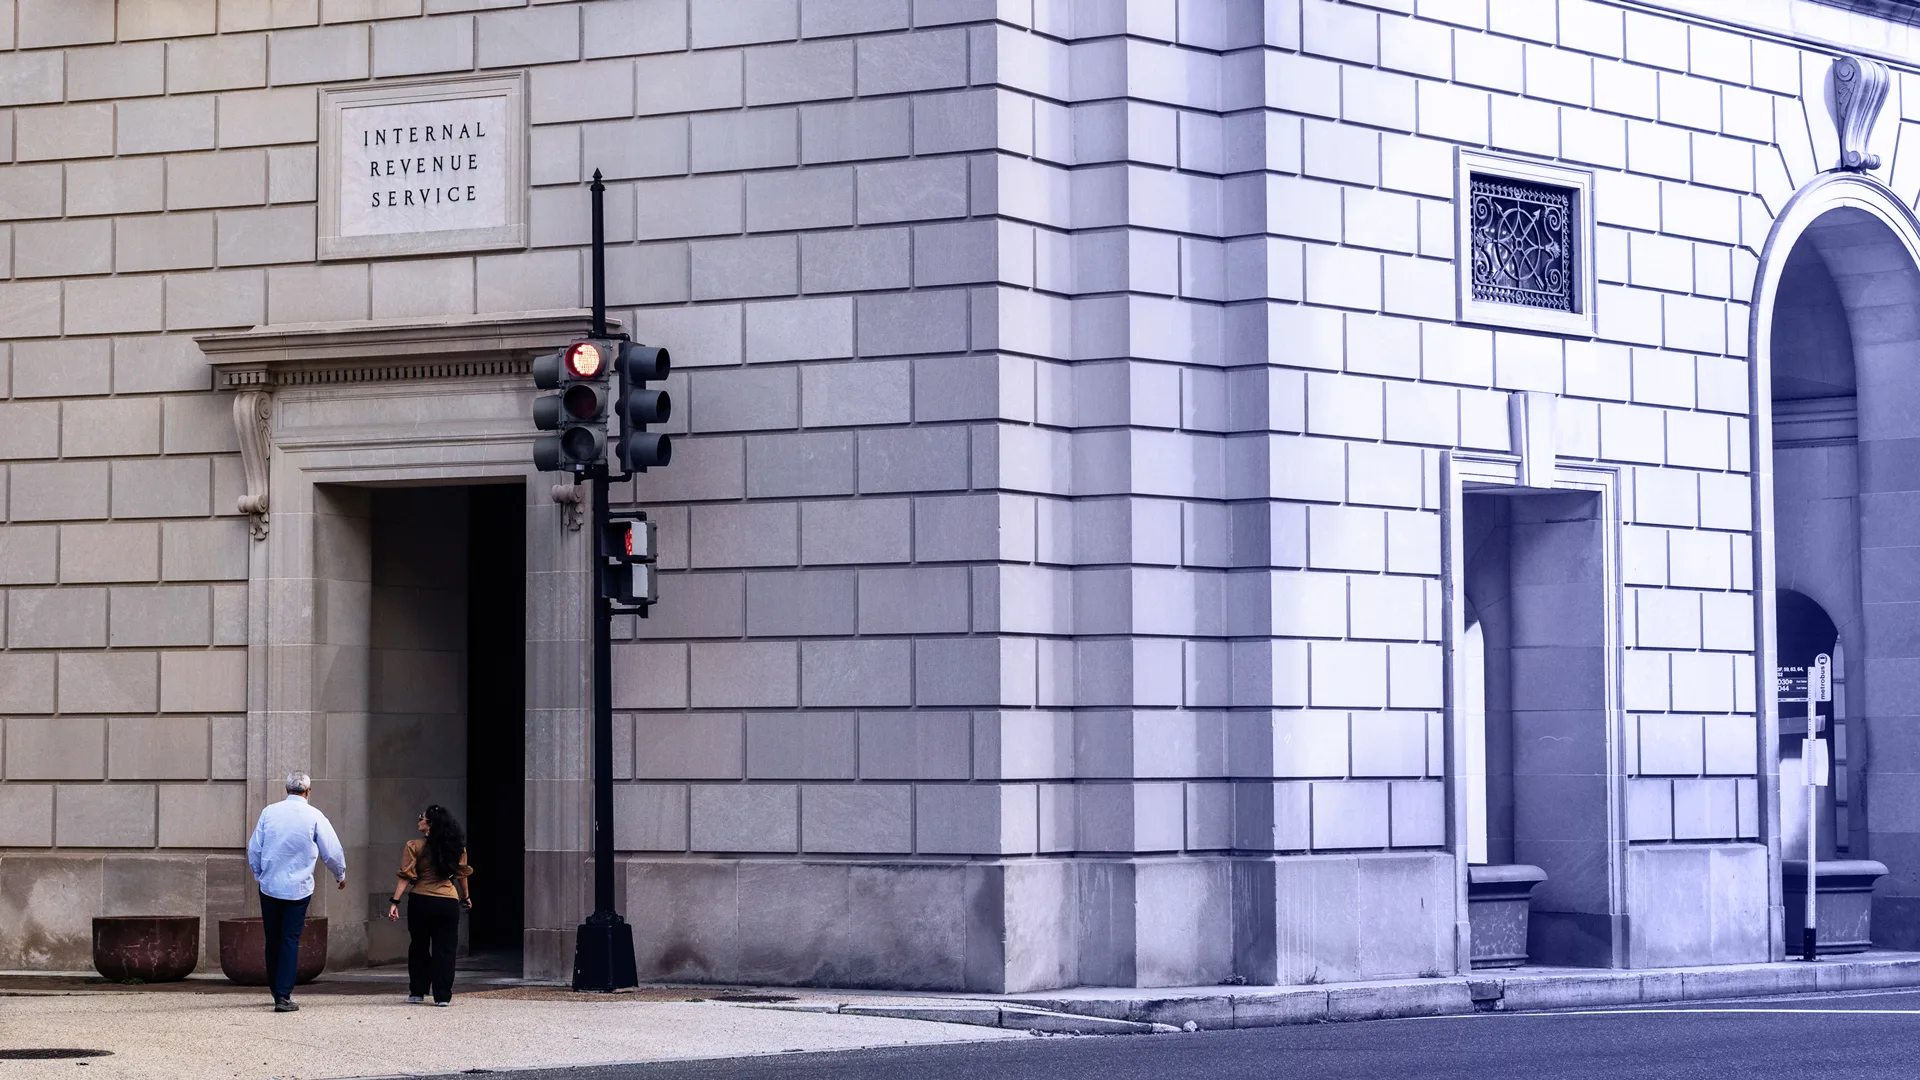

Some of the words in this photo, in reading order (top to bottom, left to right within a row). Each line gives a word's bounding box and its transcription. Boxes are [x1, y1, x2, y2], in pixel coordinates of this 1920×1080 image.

[364, 122, 485, 146] INTERNAL
[370, 154, 477, 177] REVENUE
[372, 186, 476, 207] SERVICE
